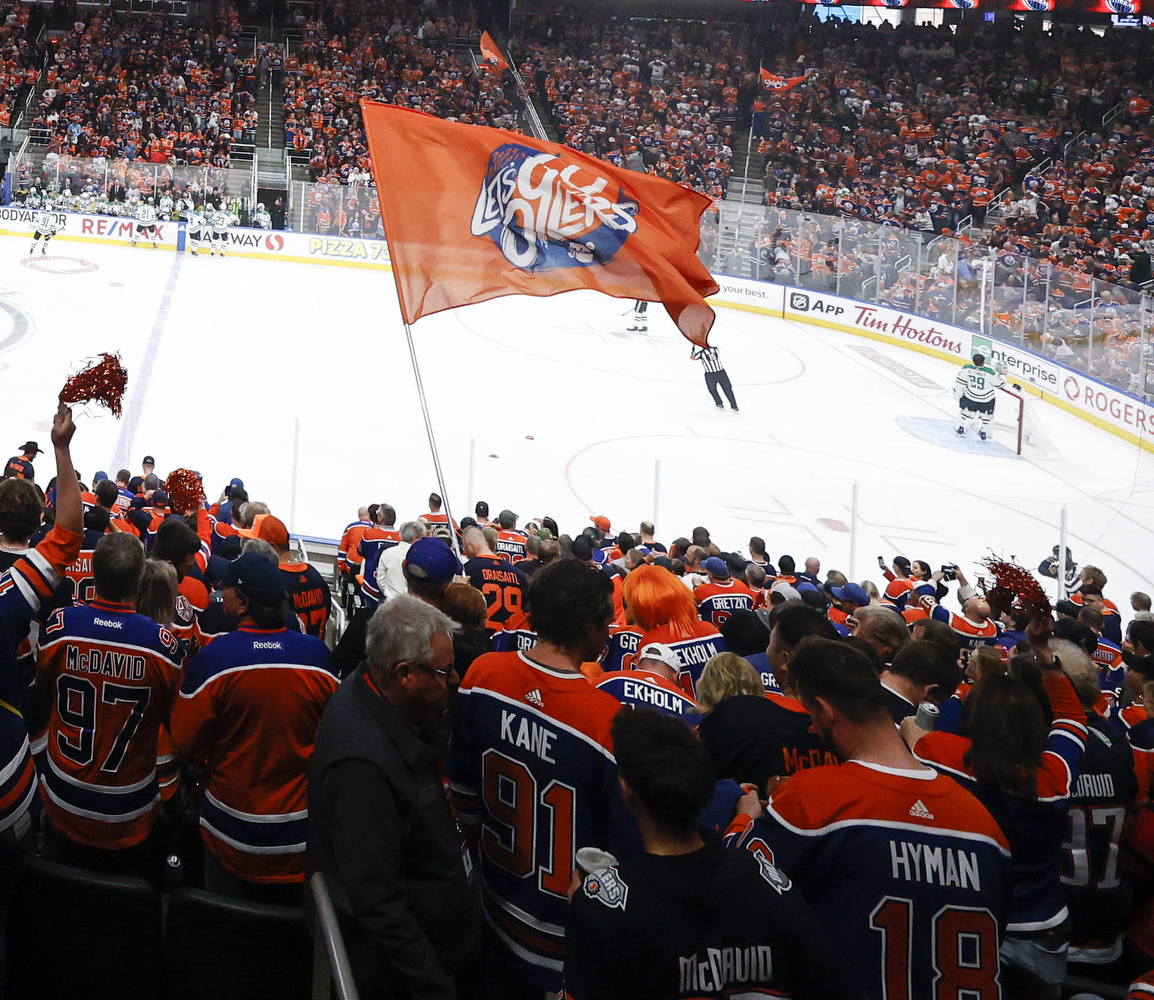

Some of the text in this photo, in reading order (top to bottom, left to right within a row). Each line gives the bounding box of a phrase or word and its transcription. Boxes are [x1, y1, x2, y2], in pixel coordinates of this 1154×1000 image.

[41, 217, 49, 228] 91
[142, 210, 149, 219] 21
[216, 216, 225, 226] 23
[309, 237, 367, 259] PIZZA
[723, 285, 768, 299] your best.
[854, 305, 963, 354] Tim Hortons
[497, 542, 524, 554] DRAISAITL
[481, 568, 520, 585] DRAISAITL
[293, 588, 324, 608] McDAVID
[93, 617, 123, 629] Reebok
[253, 641, 282, 650] Reebok
[678, 642, 718, 667] EKHOLM
[66, 645, 146, 681] McDAVID
[623, 681, 683, 715] EKHOLM
[56, 672, 151, 774] 97
[501, 709, 558, 765] KANE
[481, 748, 577, 901] 91
[889, 840, 981, 892] HYMAN
[869, 895, 1002, 1000] 18
